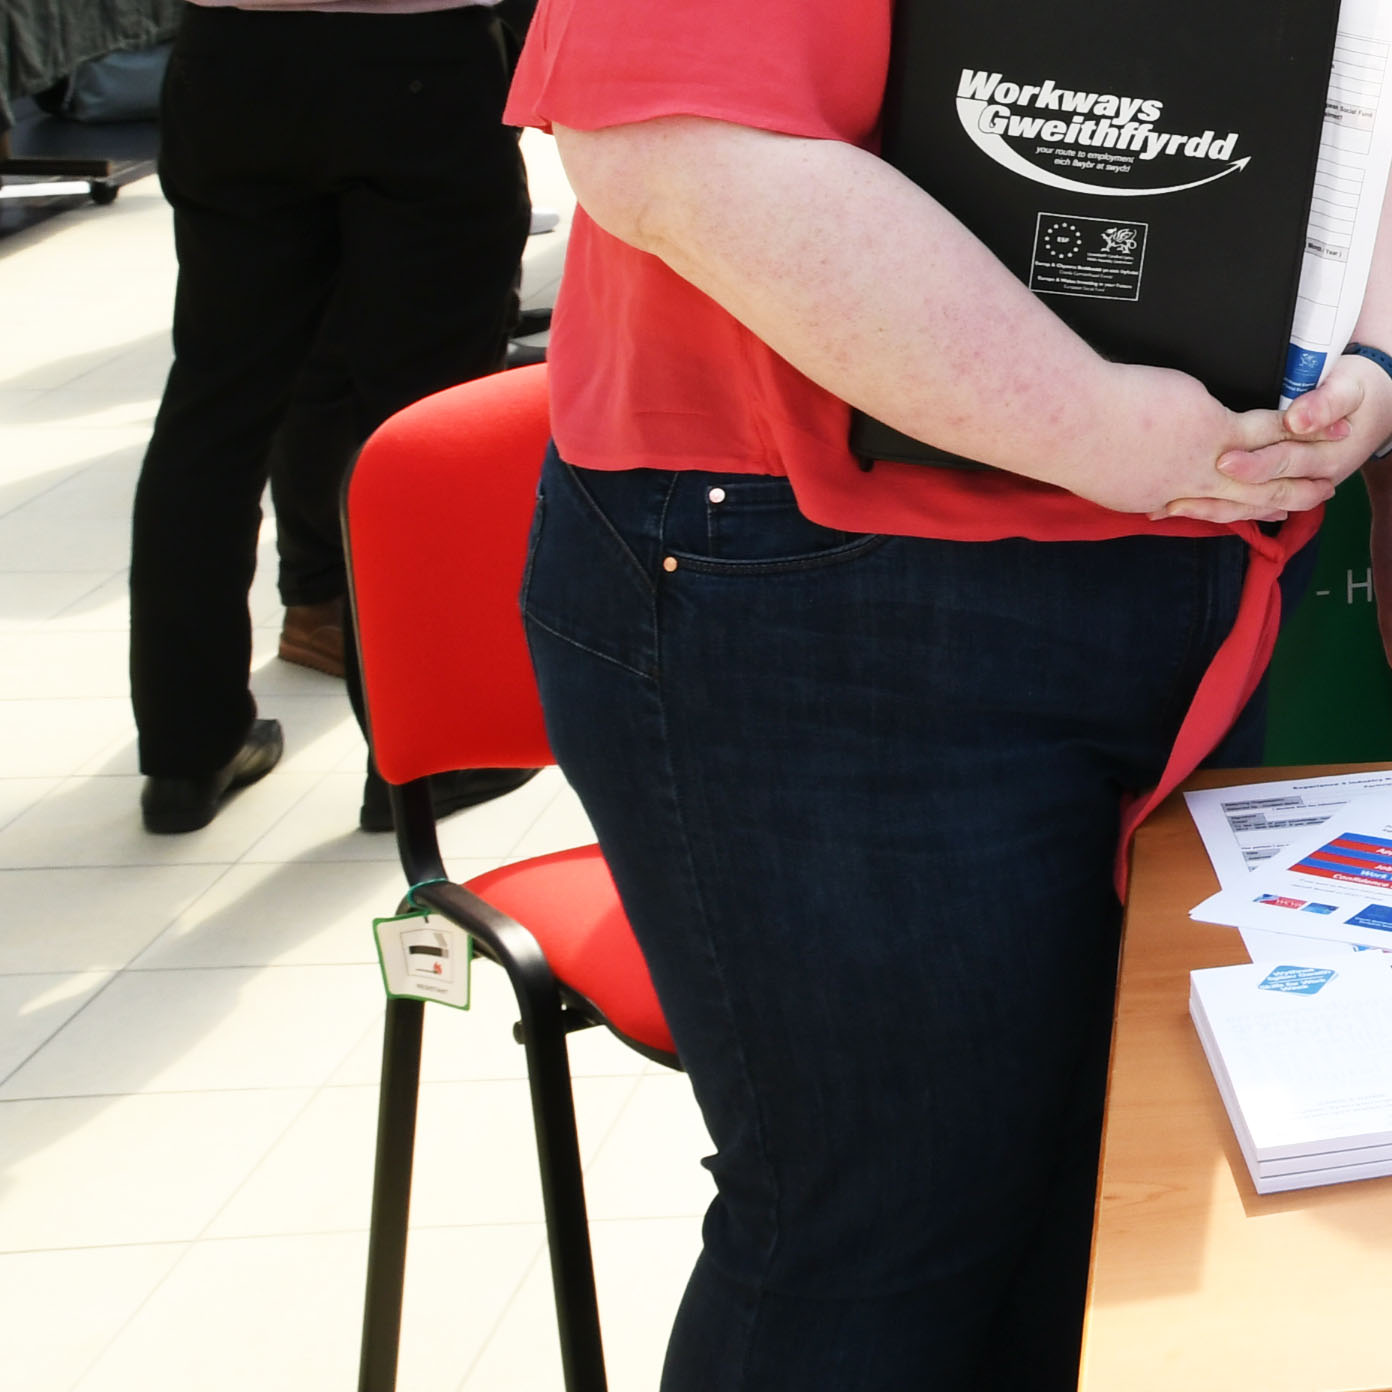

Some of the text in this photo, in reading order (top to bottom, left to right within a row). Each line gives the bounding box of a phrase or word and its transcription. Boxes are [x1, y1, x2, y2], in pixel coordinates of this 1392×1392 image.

[956, 68, 1163, 126] Workways
[978, 104, 1239, 161] Gweithffyrdd
[1035, 146, 1135, 164] your route to employment
[1054, 158, 1071, 166] eich
[1096, 163, 1104, 171] at
[1105, 164, 1131, 173] swydd
